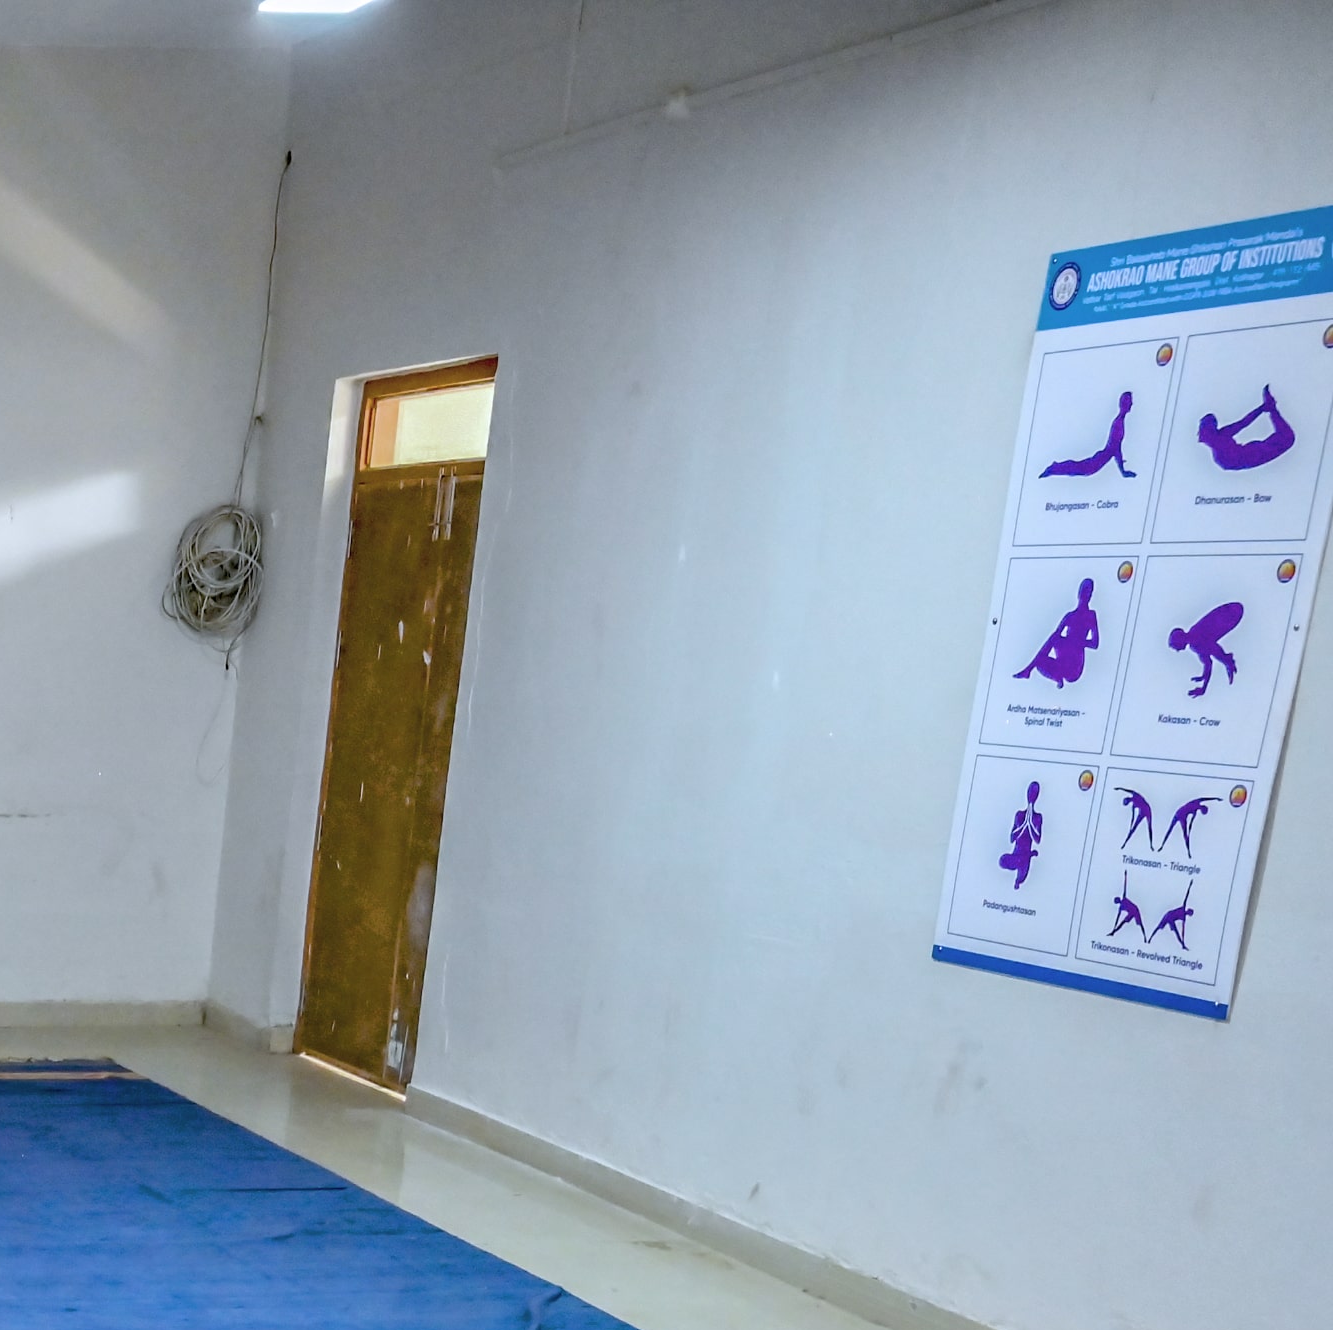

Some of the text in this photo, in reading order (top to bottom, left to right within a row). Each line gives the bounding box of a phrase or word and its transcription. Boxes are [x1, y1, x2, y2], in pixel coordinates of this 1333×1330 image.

[1086, 264, 1143, 293] ASHOKRAO
[1145, 259, 1181, 284] MANE
[1180, 253, 1222, 279] GROUP
[1220, 249, 1240, 273] OF
[1238, 235, 1326, 270] INSTITUTIONS
[1194, 493, 1272, 505] Dhanurasan Bow
[1045, 500, 1119, 513] Bhujangasan Cobra
[1007, 703, 1027, 714] Ardha
[1024, 716, 1063, 728] Spinal Twist
[1158, 714, 1221, 727] Kakasan Crow
[1122, 854, 1201, 876] Trikonasan Triangle
[982, 899, 1036, 917] Padangushtasan
[1091, 940, 1203, 971] Trikonasan Revolved Triangle
